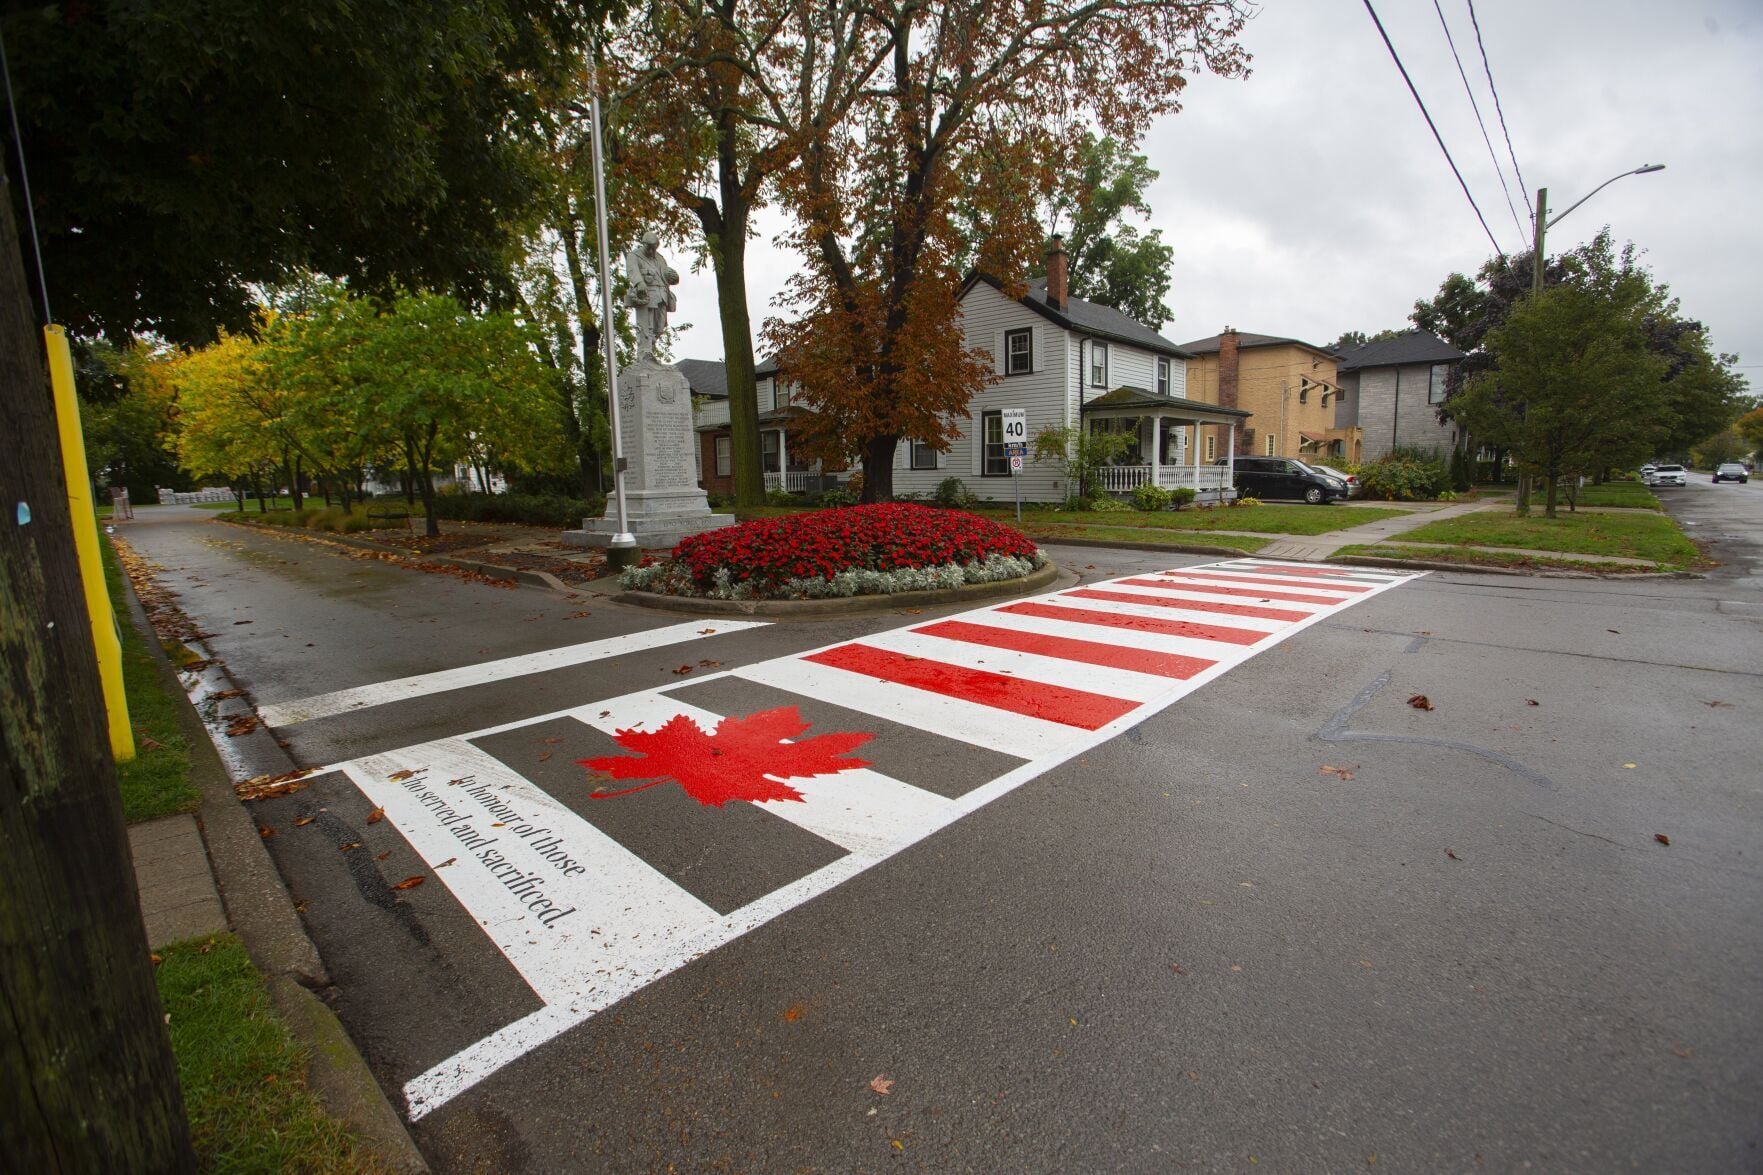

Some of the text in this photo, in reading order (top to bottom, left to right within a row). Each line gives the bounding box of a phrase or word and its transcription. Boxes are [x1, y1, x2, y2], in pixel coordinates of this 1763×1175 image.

[1006, 422, 1023, 436] 40
[466, 784, 524, 824] honour
[513, 825, 552, 838] of
[415, 791, 473, 827] served
[450, 824, 499, 850] and
[475, 849, 577, 930] sacrificed.
[530, 836, 586, 877] those
